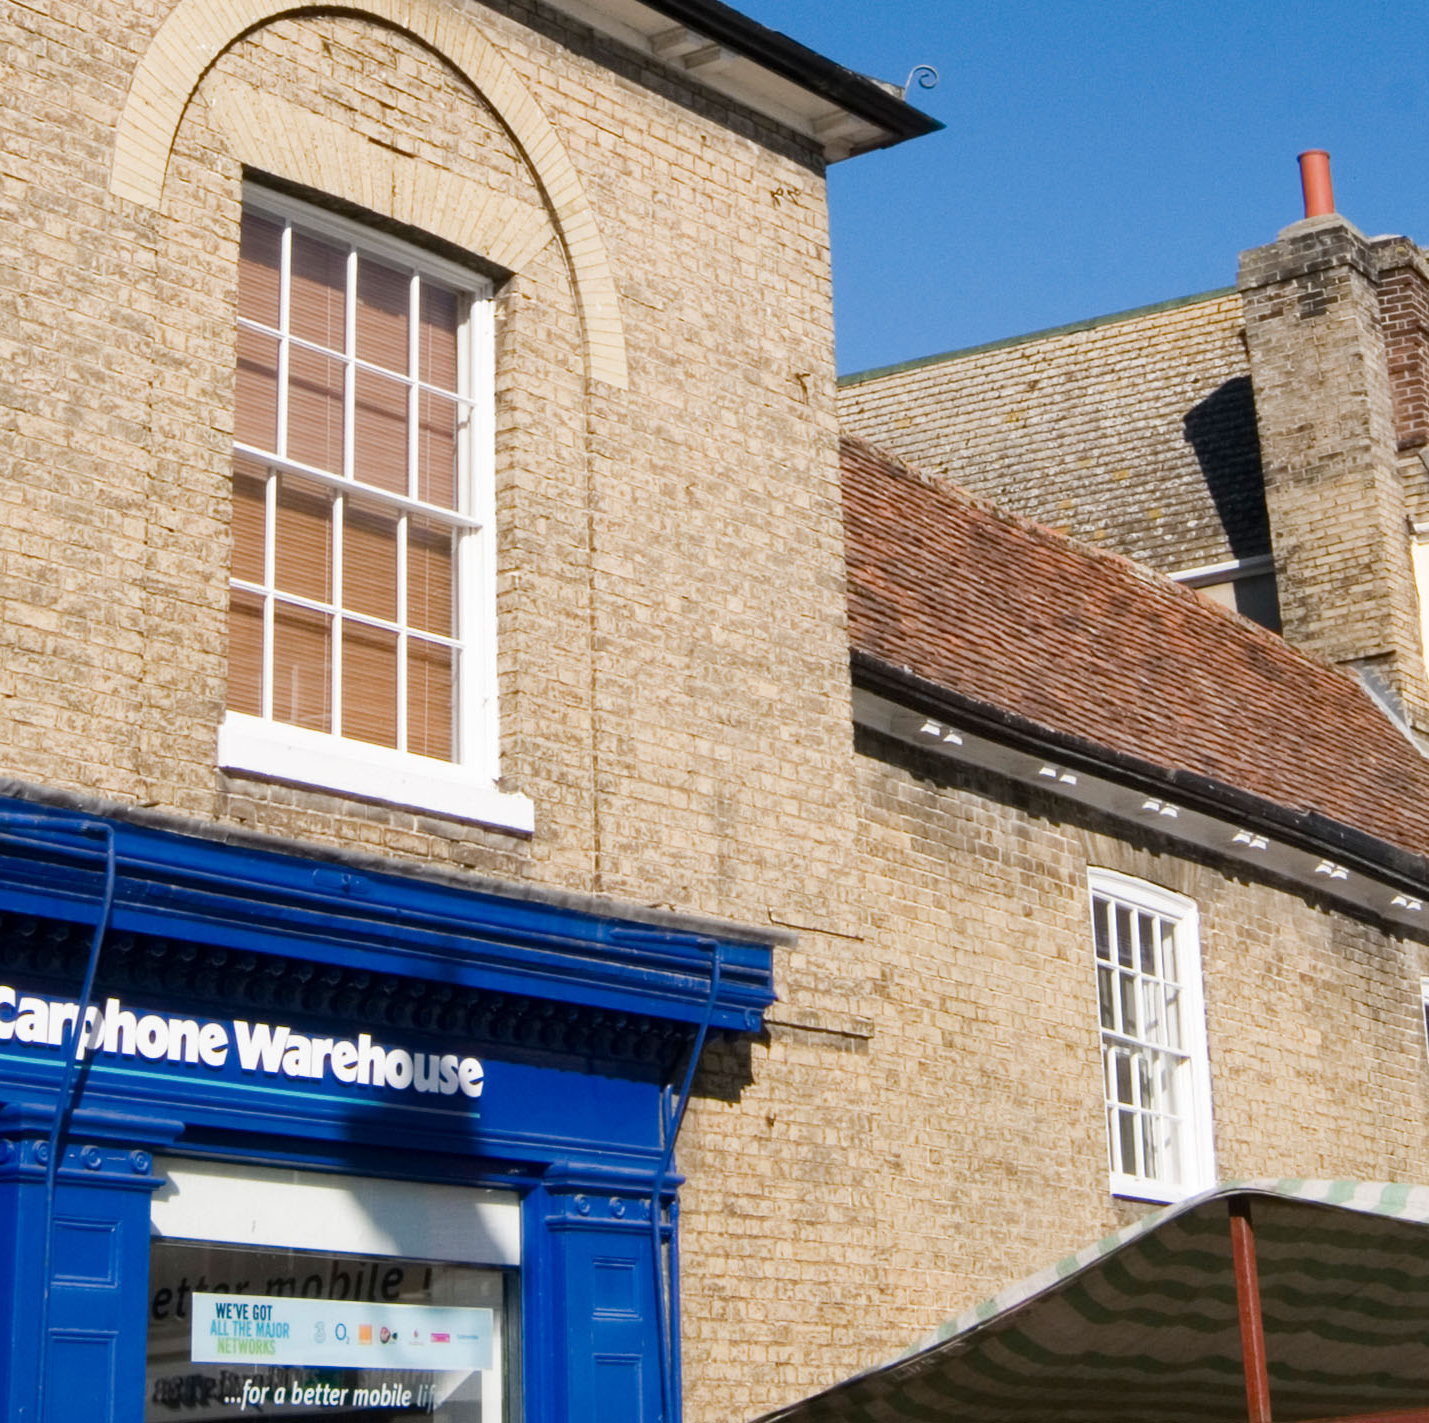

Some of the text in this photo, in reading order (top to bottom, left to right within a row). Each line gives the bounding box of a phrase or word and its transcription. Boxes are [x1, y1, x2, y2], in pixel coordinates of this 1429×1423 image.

[233, 1018, 484, 1098] Warehouse
[215, 1302, 273, 1321] WE'VE GOT
[210, 1319, 290, 1339] ALL THE MAJOR
[217, 1338, 276, 1355] NETWORKS
[274, 1386, 287, 1406] a
[291, 1380, 347, 1408] better
[352, 1382, 412, 1408] mobile
